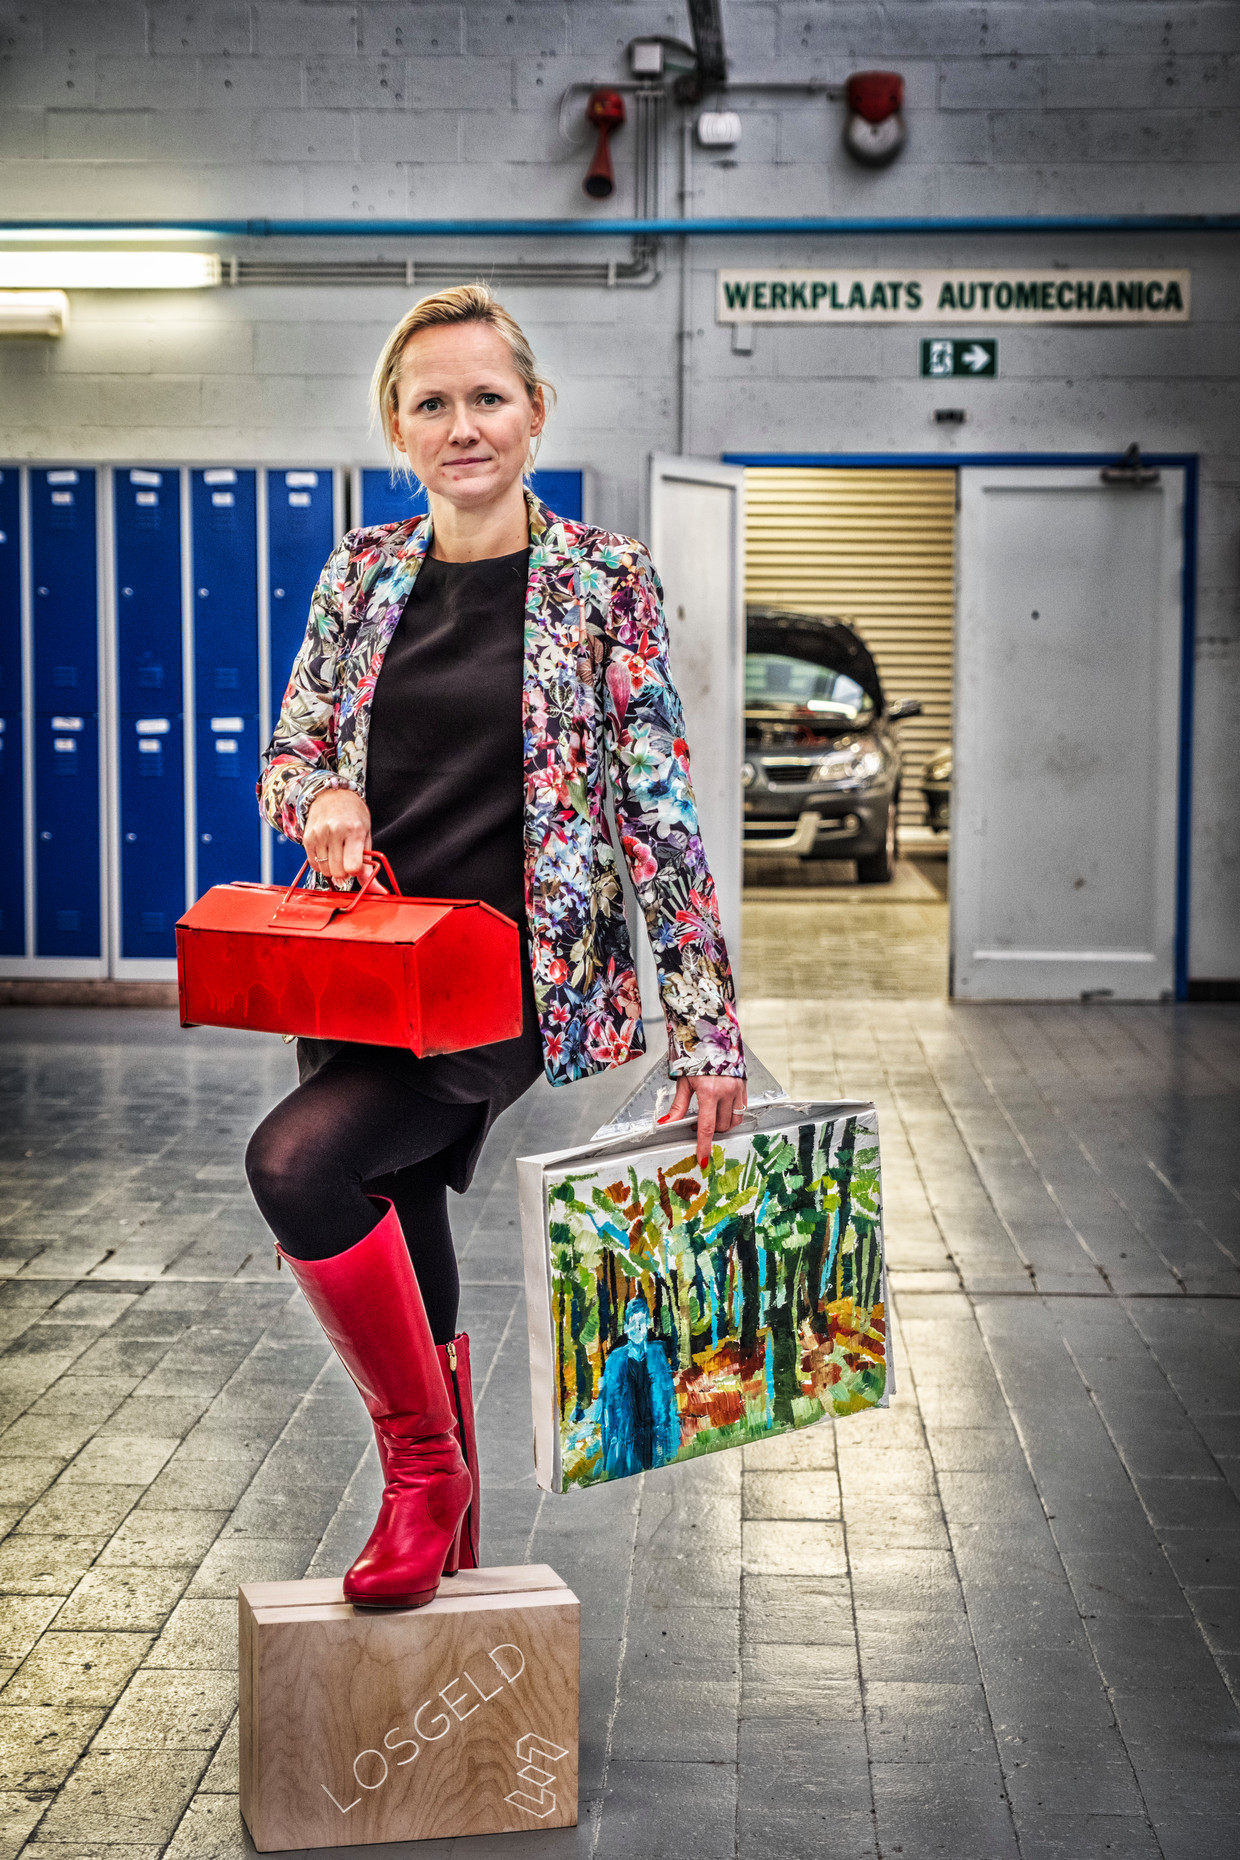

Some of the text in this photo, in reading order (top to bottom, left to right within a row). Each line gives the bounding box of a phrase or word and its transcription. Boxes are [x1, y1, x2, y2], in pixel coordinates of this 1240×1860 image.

[723, 281, 1184, 311] WERKPLAATS AUTOMECHANICA
[321, 1643, 525, 1813] LOSGELD
